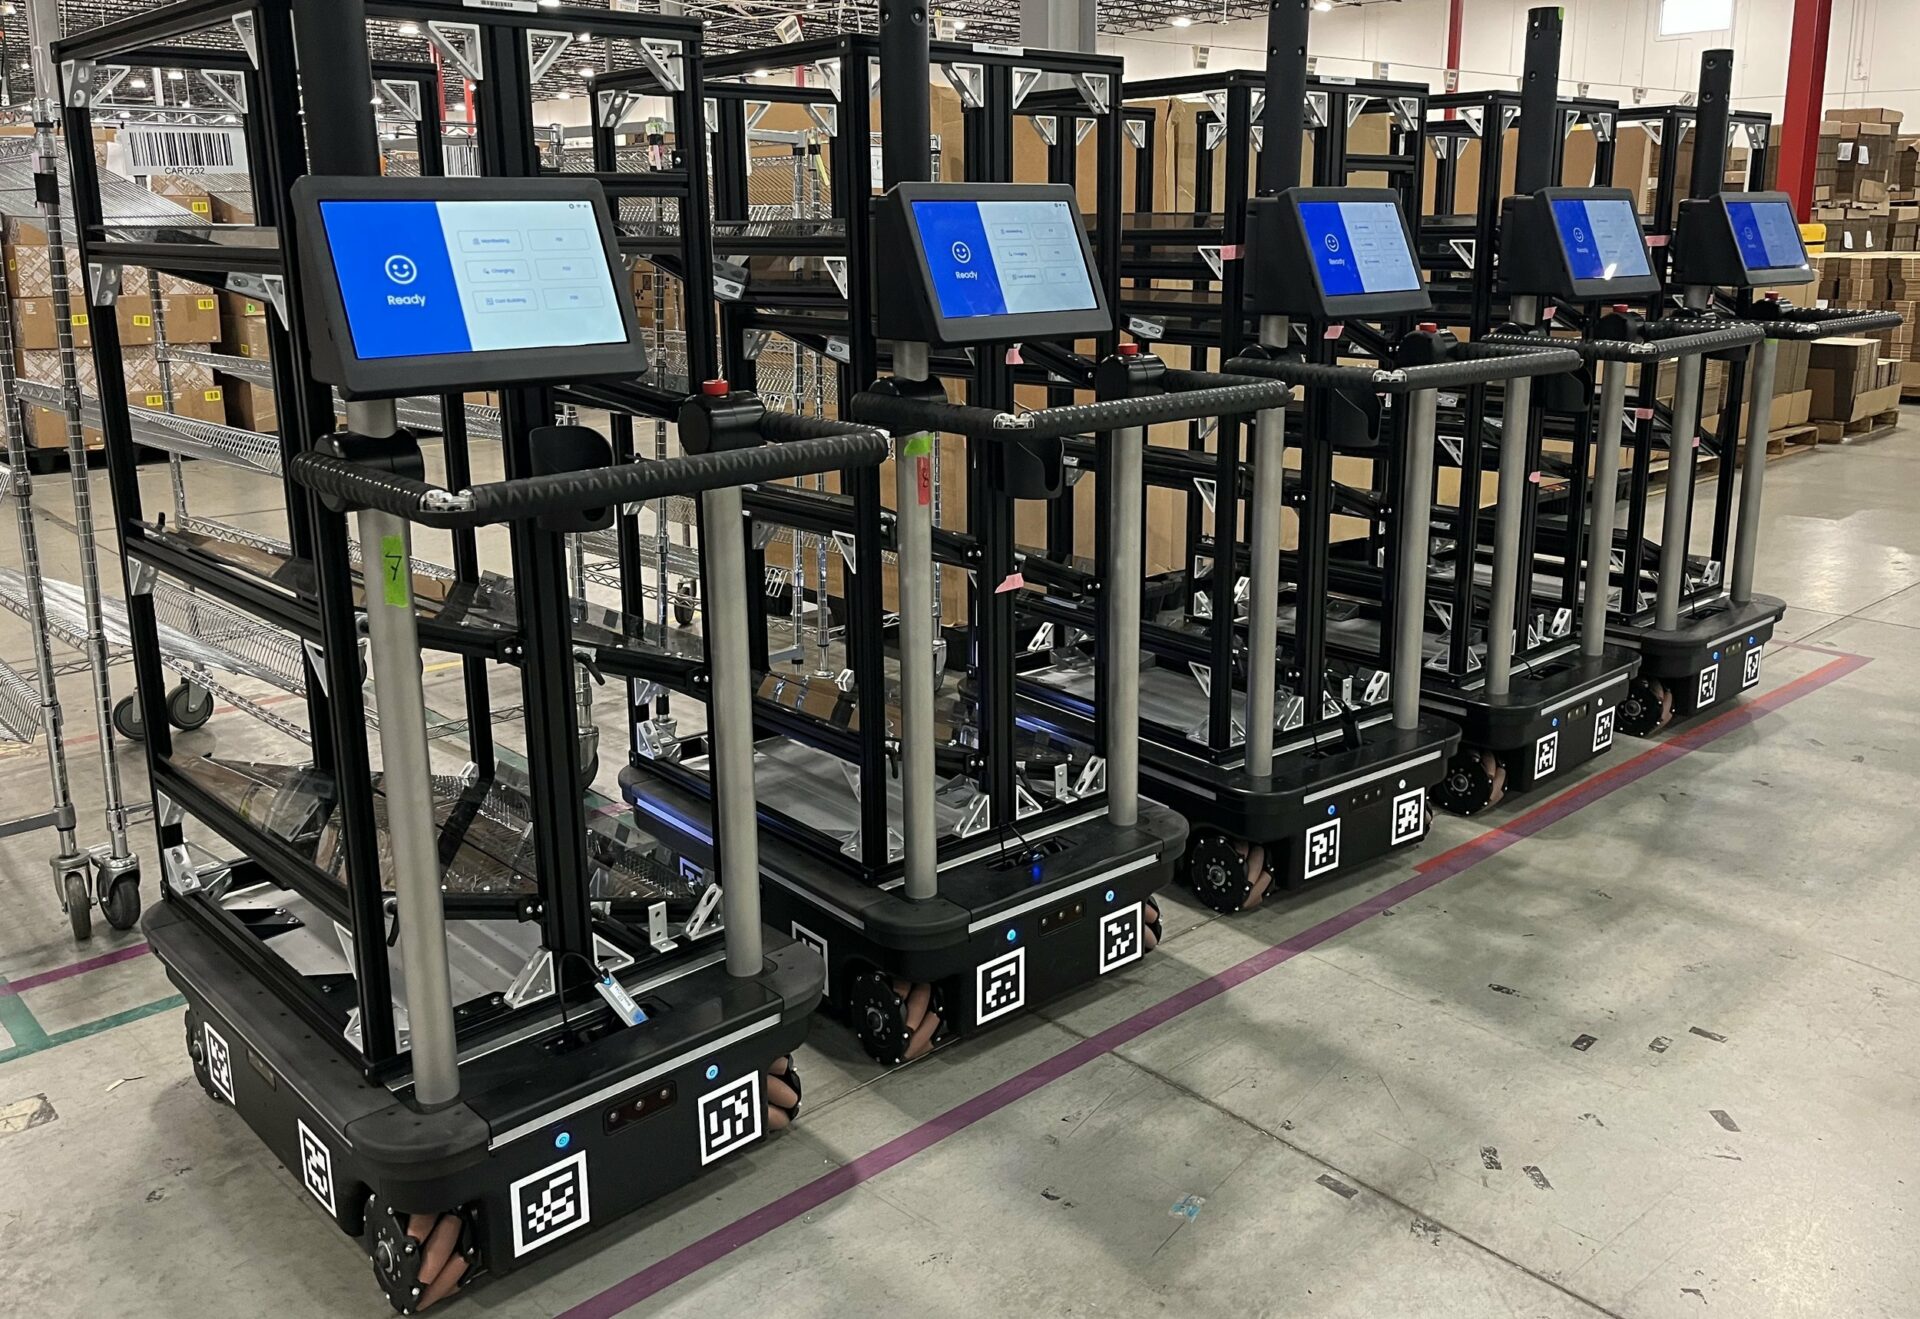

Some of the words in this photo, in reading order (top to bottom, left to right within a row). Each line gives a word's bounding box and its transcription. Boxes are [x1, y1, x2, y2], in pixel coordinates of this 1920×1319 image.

[164, 167, 205, 175] CART232
[955, 270, 978, 281] Ready
[387, 293, 426, 307] Ready
[384, 552, 403, 581] 7
